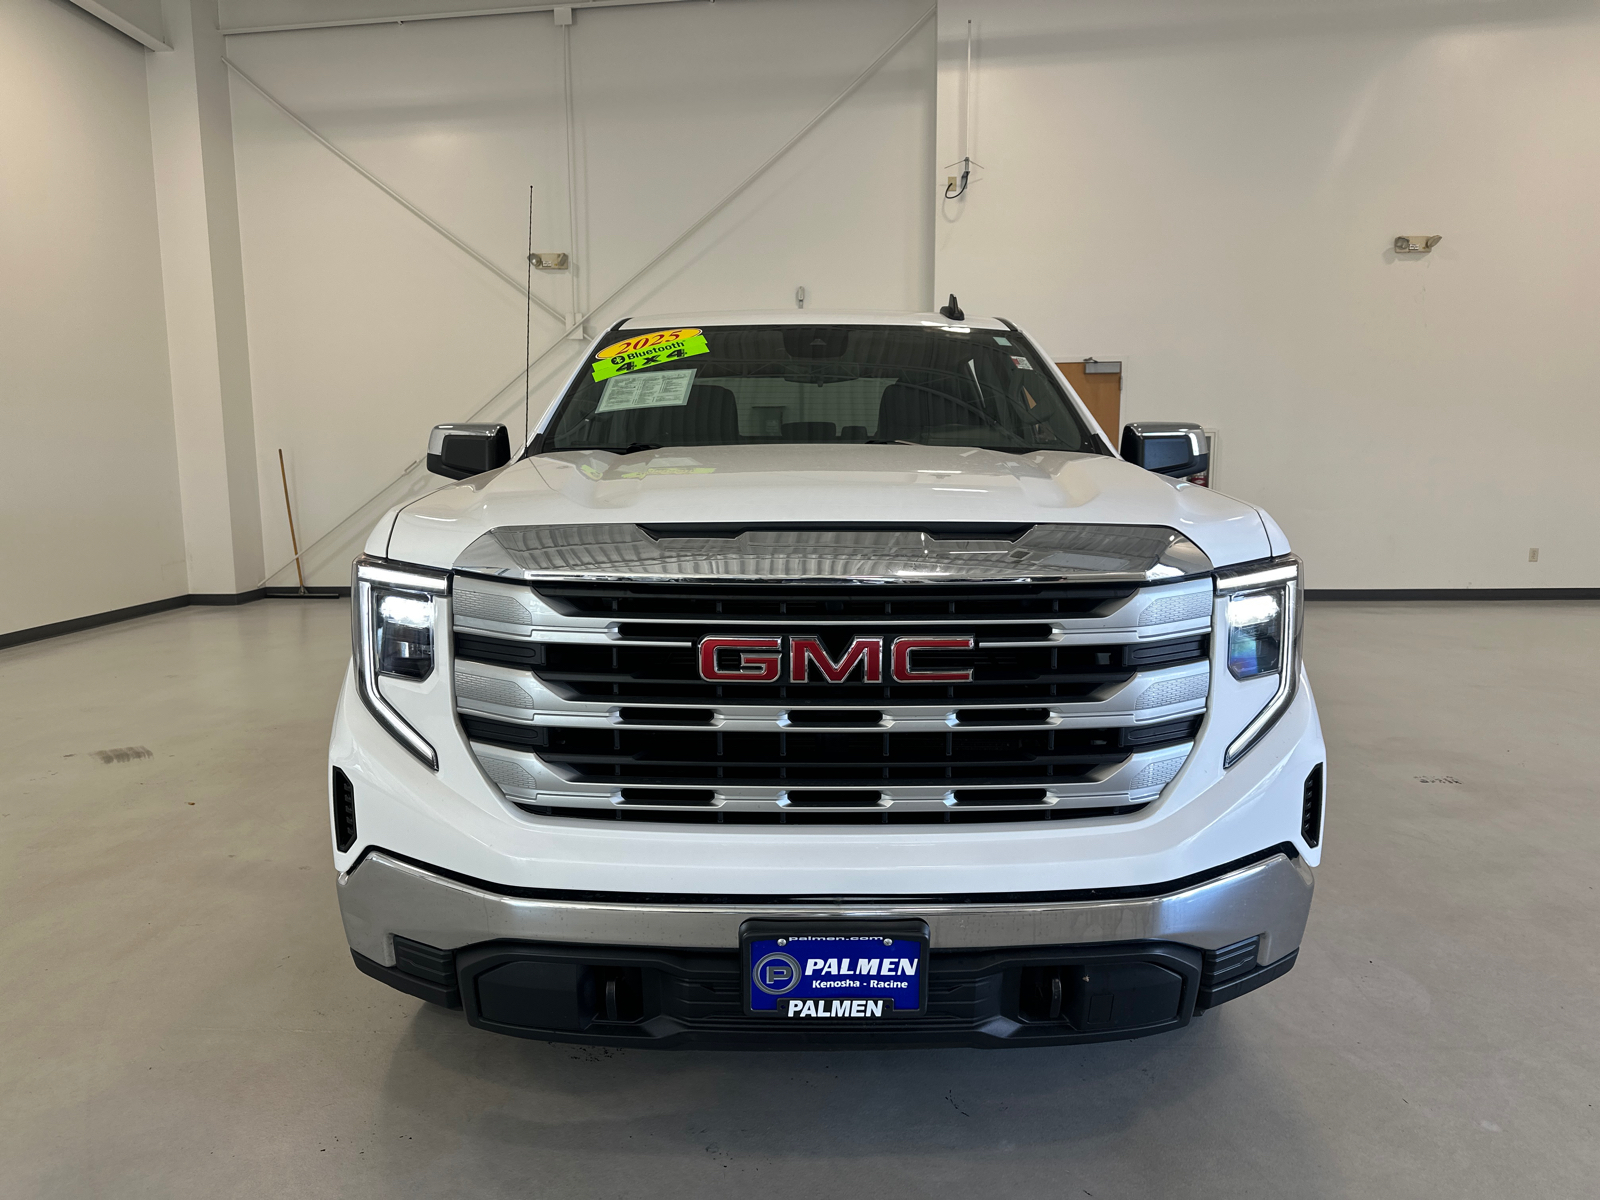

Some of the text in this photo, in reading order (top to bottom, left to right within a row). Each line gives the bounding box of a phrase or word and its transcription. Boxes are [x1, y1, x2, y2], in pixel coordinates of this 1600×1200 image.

[615, 329, 683, 356] 2025
[626, 341, 685, 361] Bluetooth
[698, 635, 975, 684] GMC
[804, 958, 919, 976] PALMEN
[812, 980, 860, 989] Kenosha
[869, 980, 908, 989] Racine
[787, 1000, 884, 1018] PALMEN
